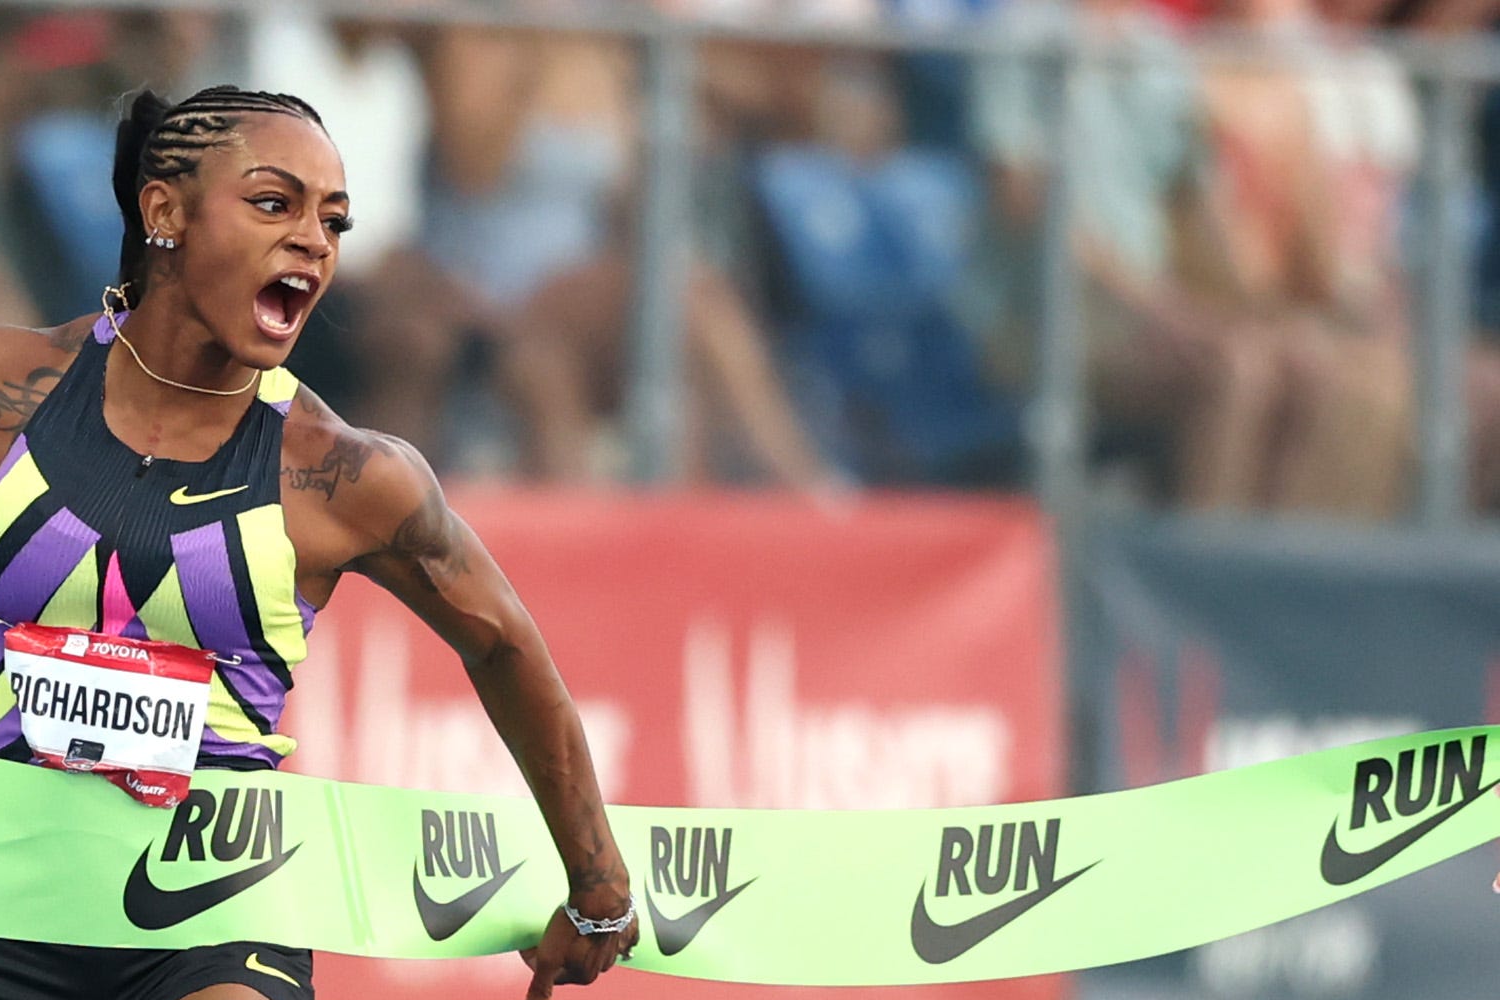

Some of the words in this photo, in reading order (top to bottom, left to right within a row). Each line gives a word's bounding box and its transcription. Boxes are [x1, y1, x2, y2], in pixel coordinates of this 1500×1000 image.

[92, 642, 149, 661] TOYOTA
[1349, 735, 1489, 831] RUN
[160, 787, 284, 863] RUN
[421, 808, 500, 879] RUN
[650, 825, 733, 898] RUN
[935, 818, 1062, 897] RUN
